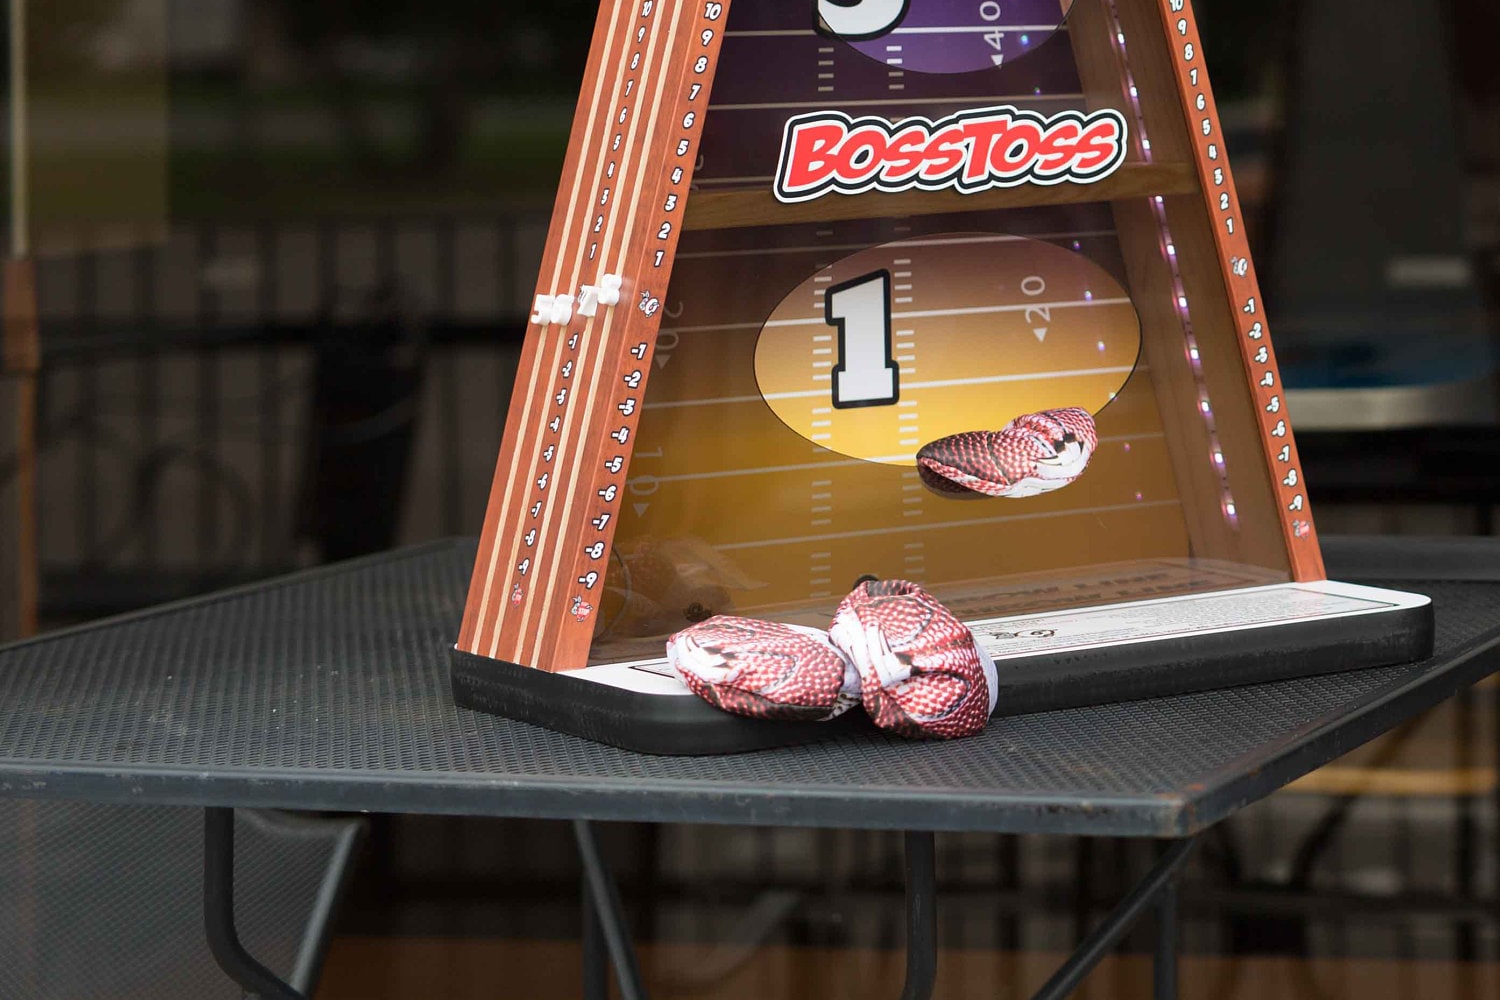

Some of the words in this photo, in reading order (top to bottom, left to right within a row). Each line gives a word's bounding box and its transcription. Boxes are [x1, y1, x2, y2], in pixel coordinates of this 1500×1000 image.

[703, 1, 723, 21] 10
[979, 0, 1004, 51] 40
[1176, 18, 1188, 36] 9
[700, 29, 714, 47] 9
[1183, 42, 1195, 61] 8
[693, 55, 709, 74] 8
[688, 83, 702, 101] 7
[1195, 93, 1206, 111] 6
[682, 111, 696, 129] 6
[1201, 118, 1212, 136] 5
[676, 139, 690, 157] 5
[670, 167, 684, 185] 4
[663, 194, 678, 212] 3
[1219, 192, 1230, 211] 2
[657, 221, 672, 240] 2
[1225, 217, 1234, 234] 1
[653, 250, 665, 267] 1
[1020, 275, 1050, 324] 20
[1243, 297, 1256, 314] -1
[825, 268, 899, 409] 1
[1248, 321, 1263, 340] -2
[630, 342, 648, 360] -1
[623, 370, 642, 389] -2
[617, 398, 636, 416] -3
[610, 426, 630, 445] -4
[1271, 419, 1287, 438] -6
[604, 456, 624, 474] -5
[1282, 468, 1298, 487] -8
[597, 484, 618, 503] -6
[591, 513, 611, 531] -7
[584, 541, 605, 560] -8
[577, 571, 599, 589] -9
